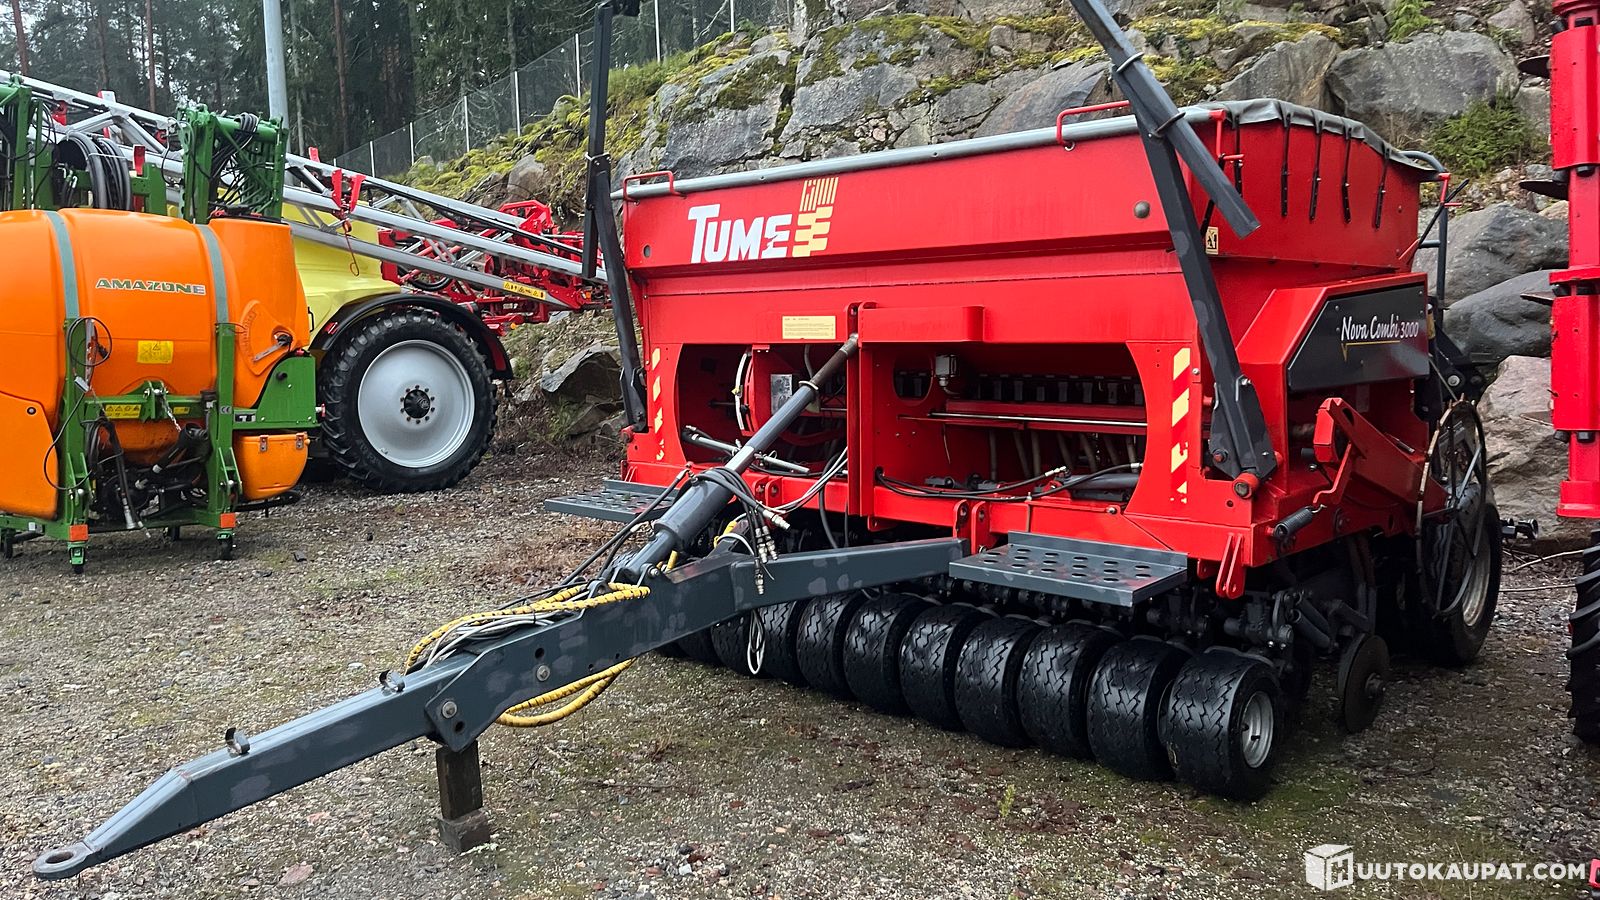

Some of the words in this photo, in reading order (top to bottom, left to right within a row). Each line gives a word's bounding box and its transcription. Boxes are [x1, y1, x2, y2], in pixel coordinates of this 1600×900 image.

[688, 204, 792, 263] TUME
[96, 279, 206, 295] AMAZONE
[1341, 316, 1369, 340] Nova
[1370, 314, 1400, 339] Combi
[1400, 322, 1419, 339] 3000
